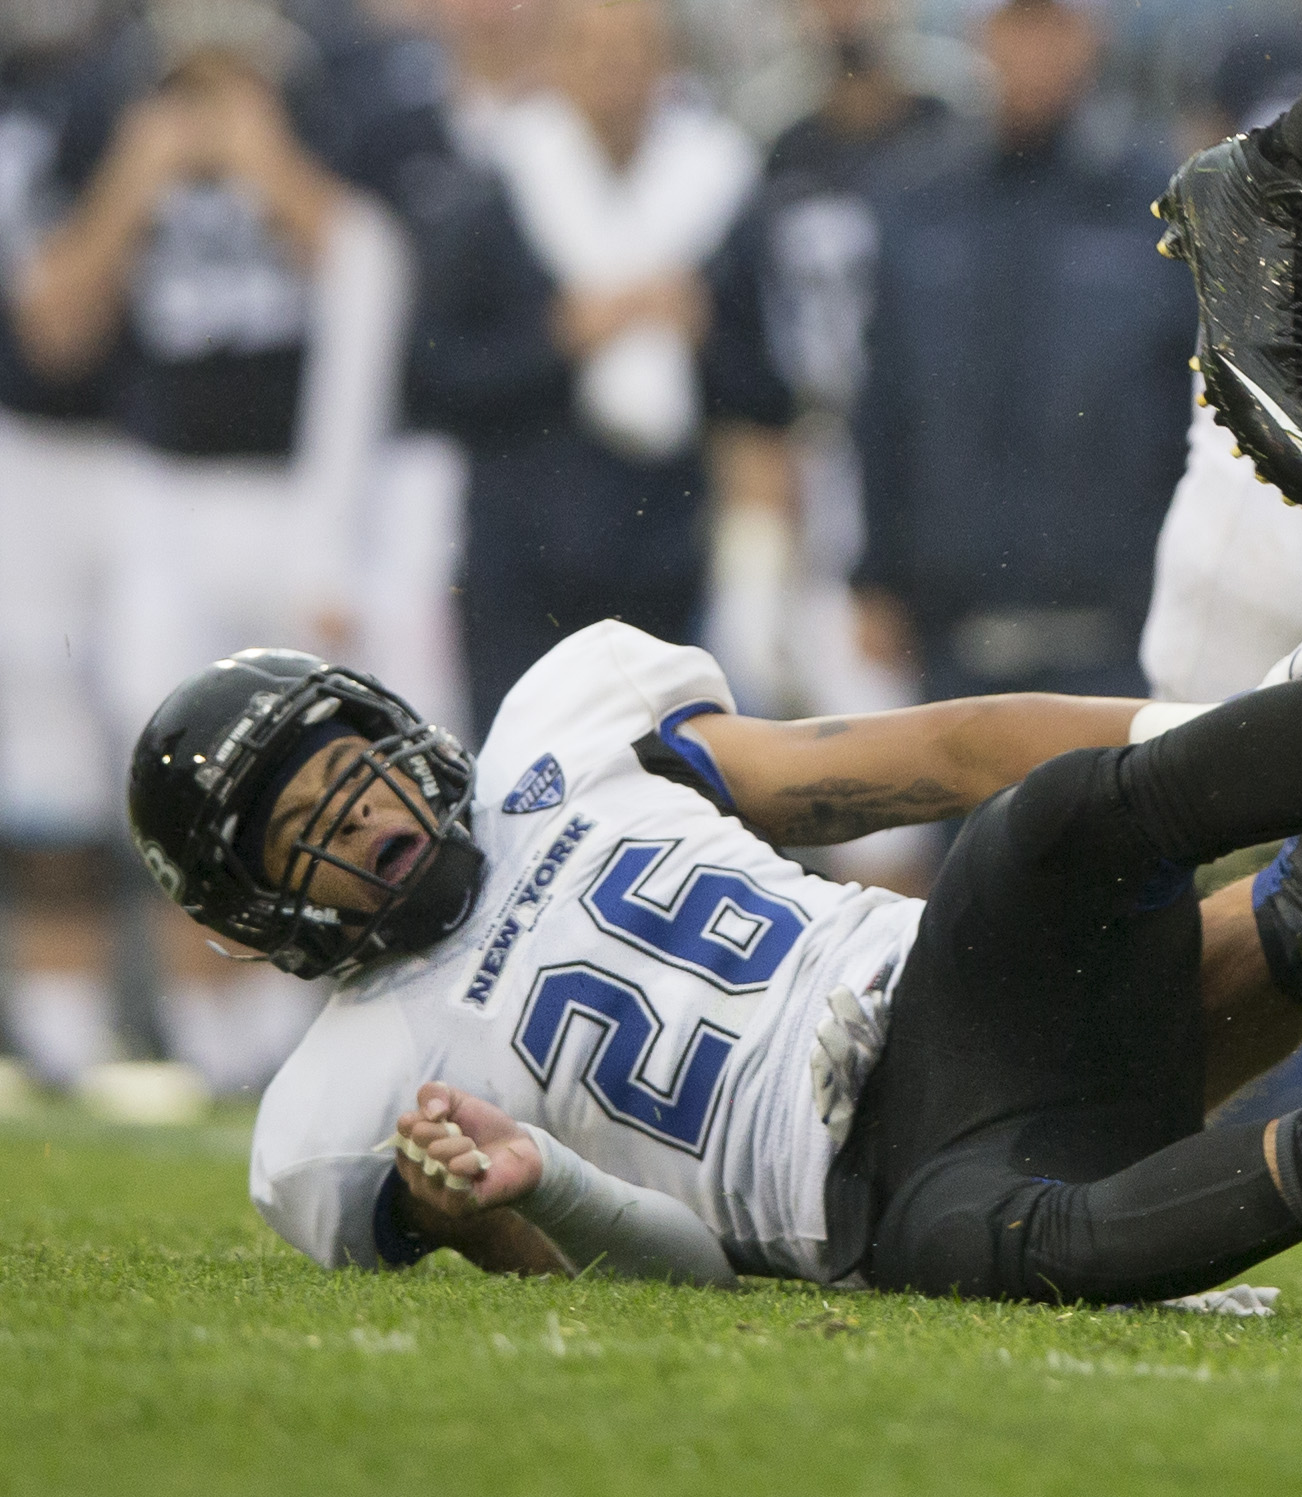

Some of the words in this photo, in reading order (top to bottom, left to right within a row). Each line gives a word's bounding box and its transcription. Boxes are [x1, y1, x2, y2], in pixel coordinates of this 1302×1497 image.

[462, 915, 521, 1011] NEW
[516, 813, 598, 907] YORK
[511, 837, 813, 1161] 26
